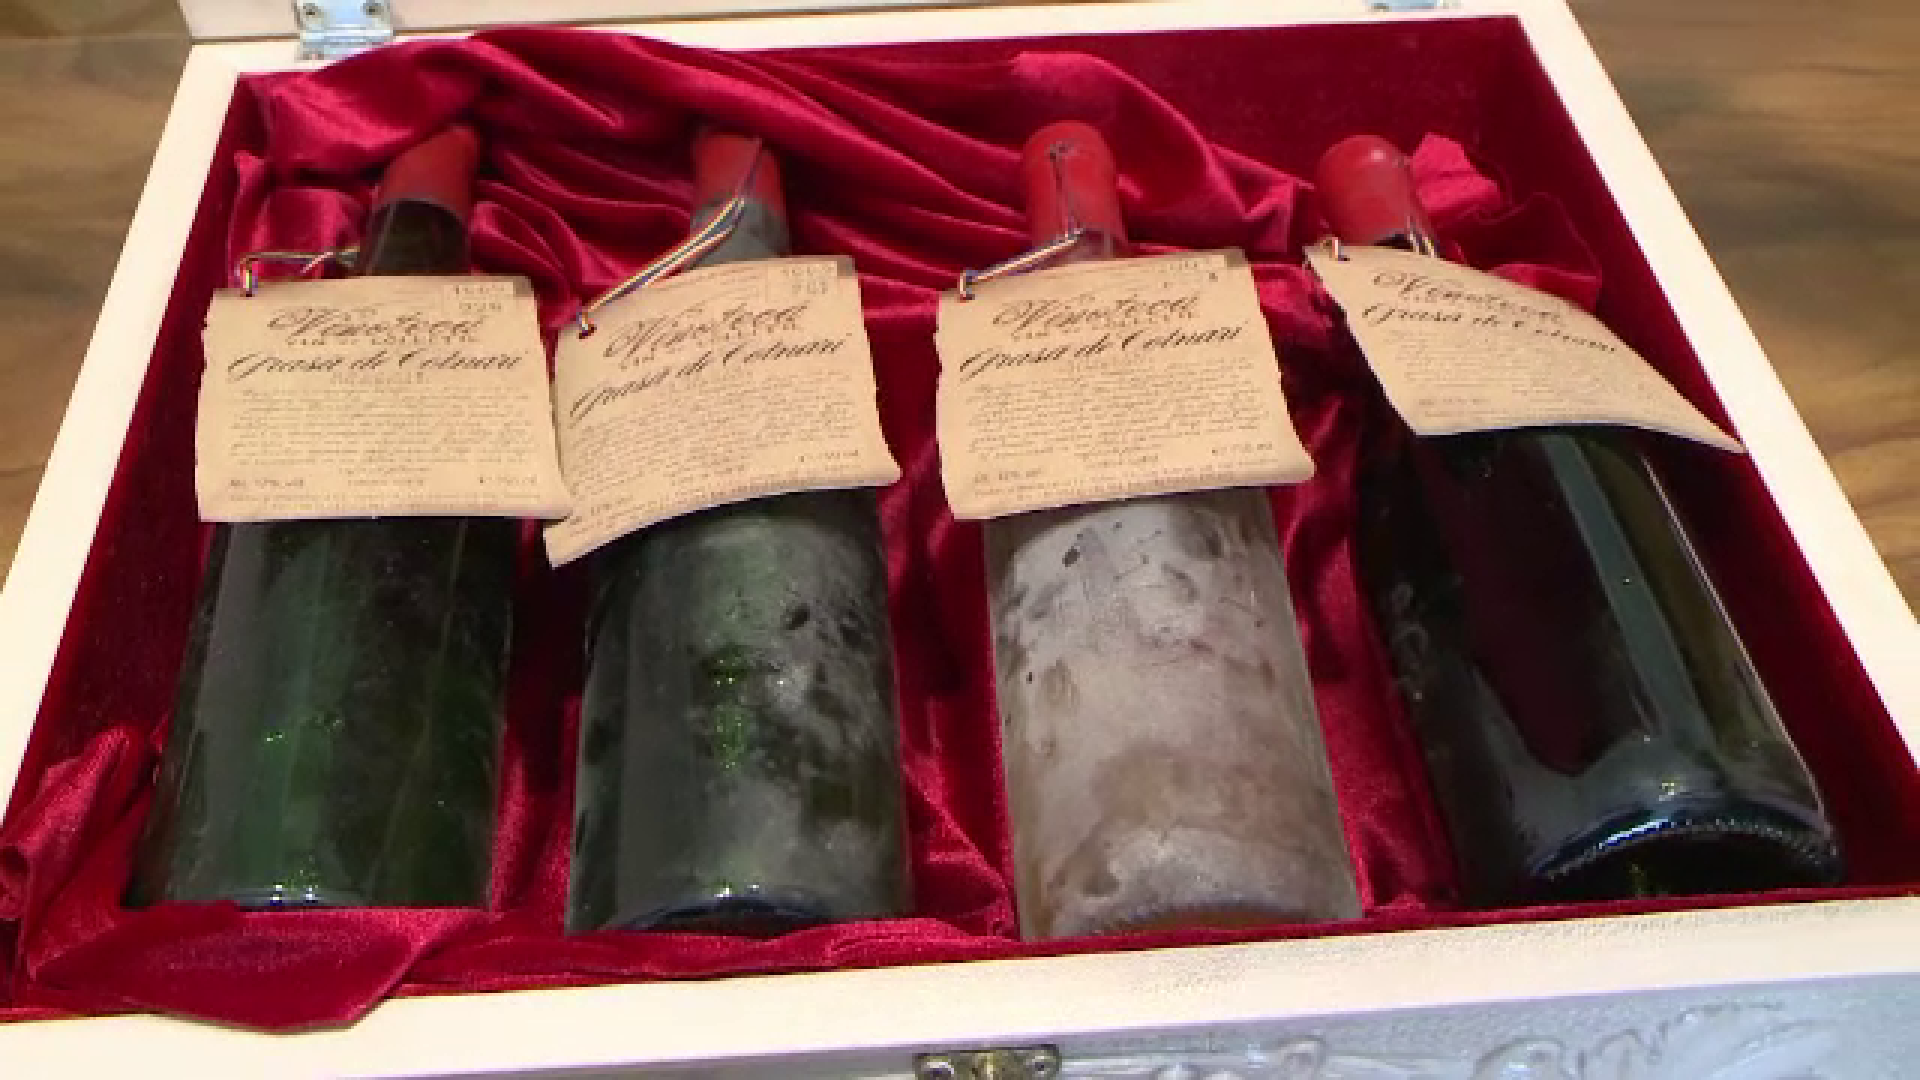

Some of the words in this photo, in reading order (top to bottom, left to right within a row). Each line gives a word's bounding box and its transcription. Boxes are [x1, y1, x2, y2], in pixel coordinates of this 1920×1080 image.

[1074, 333, 1113, 358] de
[350, 350, 391, 372] de
[675, 350, 716, 378] de
